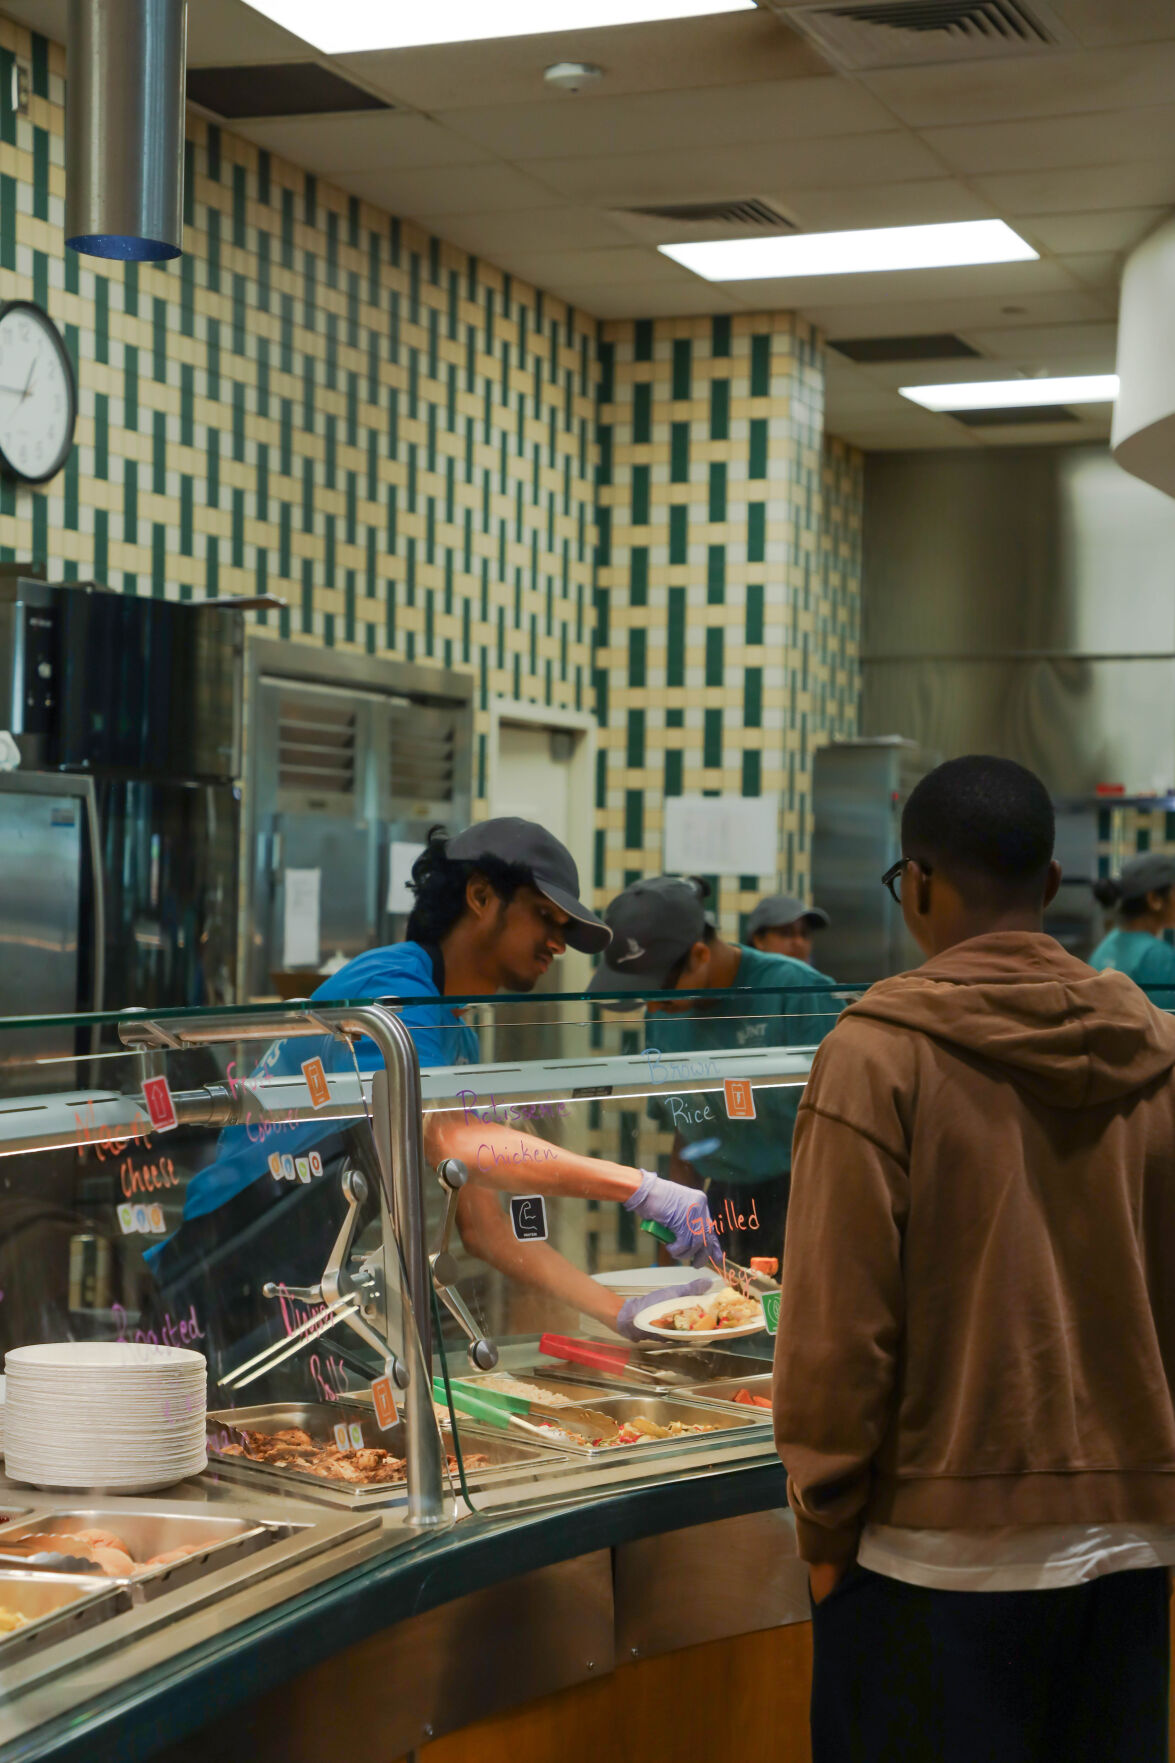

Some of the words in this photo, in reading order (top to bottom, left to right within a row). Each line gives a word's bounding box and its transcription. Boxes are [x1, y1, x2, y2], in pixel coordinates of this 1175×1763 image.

[641, 1048, 720, 1085] Brown
[664, 1096, 717, 1127] Rice
[477, 1139, 558, 1172] Chicken
[121, 1157, 179, 1198] Cheese
[686, 1198, 760, 1247] Grilled
